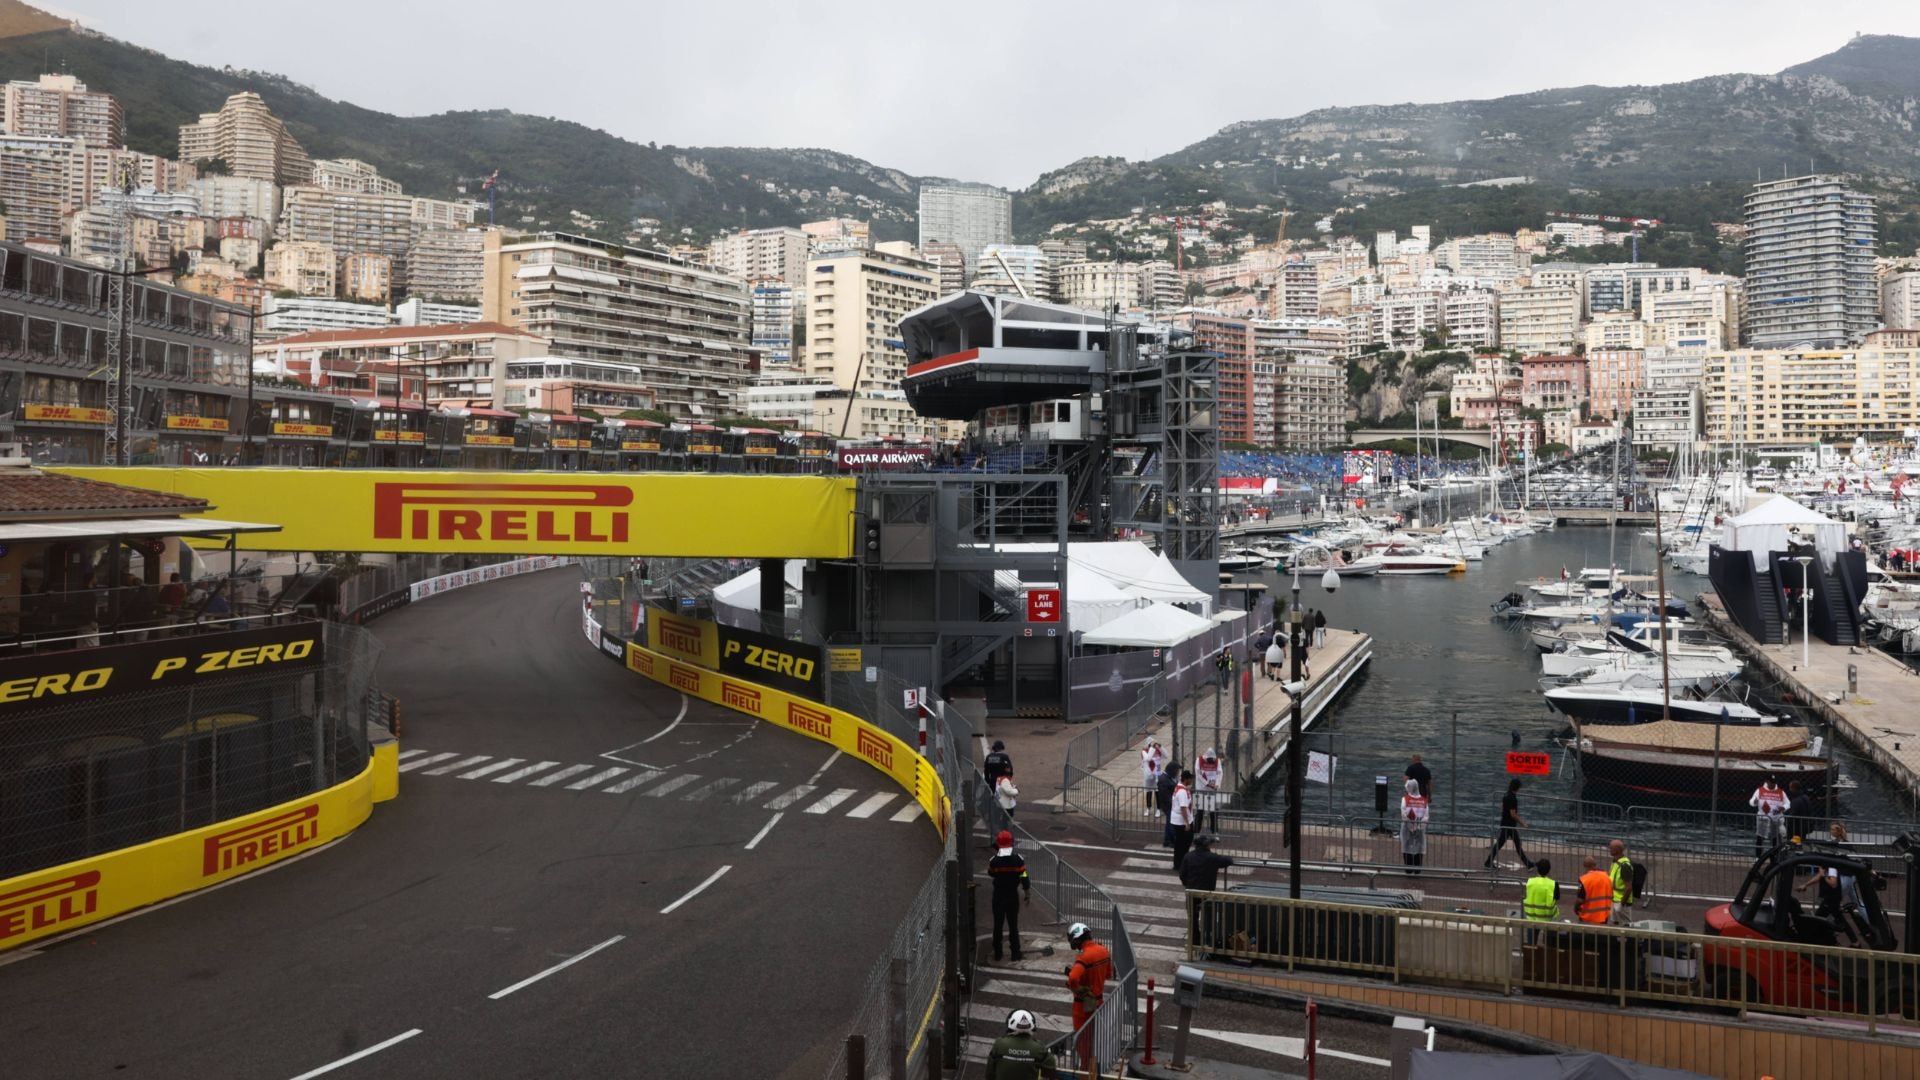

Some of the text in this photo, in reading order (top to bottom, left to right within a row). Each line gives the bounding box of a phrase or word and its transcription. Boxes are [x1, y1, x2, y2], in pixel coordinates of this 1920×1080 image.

[42, 408, 72, 418] DHL
[179, 418, 201, 427] DHL
[285, 424, 304, 432] DHL
[844, 454, 925, 465] QATAR AIRWAYS
[374, 482, 634, 542] PIRELLI
[659, 616, 701, 656] PIRELLI
[151, 639, 314, 680] P ZERO
[633, 649, 653, 675] PIRELLI
[724, 639, 742, 658] P
[744, 645, 815, 681] ZERO
[670, 664, 700, 692] PIRELLI
[722, 681, 761, 713] PIRELLI
[788, 701, 832, 739] PIRELLI
[857, 727, 893, 771] PIRELLI
[1509, 755, 1546, 765] SORTIE
[203, 804, 320, 877] PIRELLI
